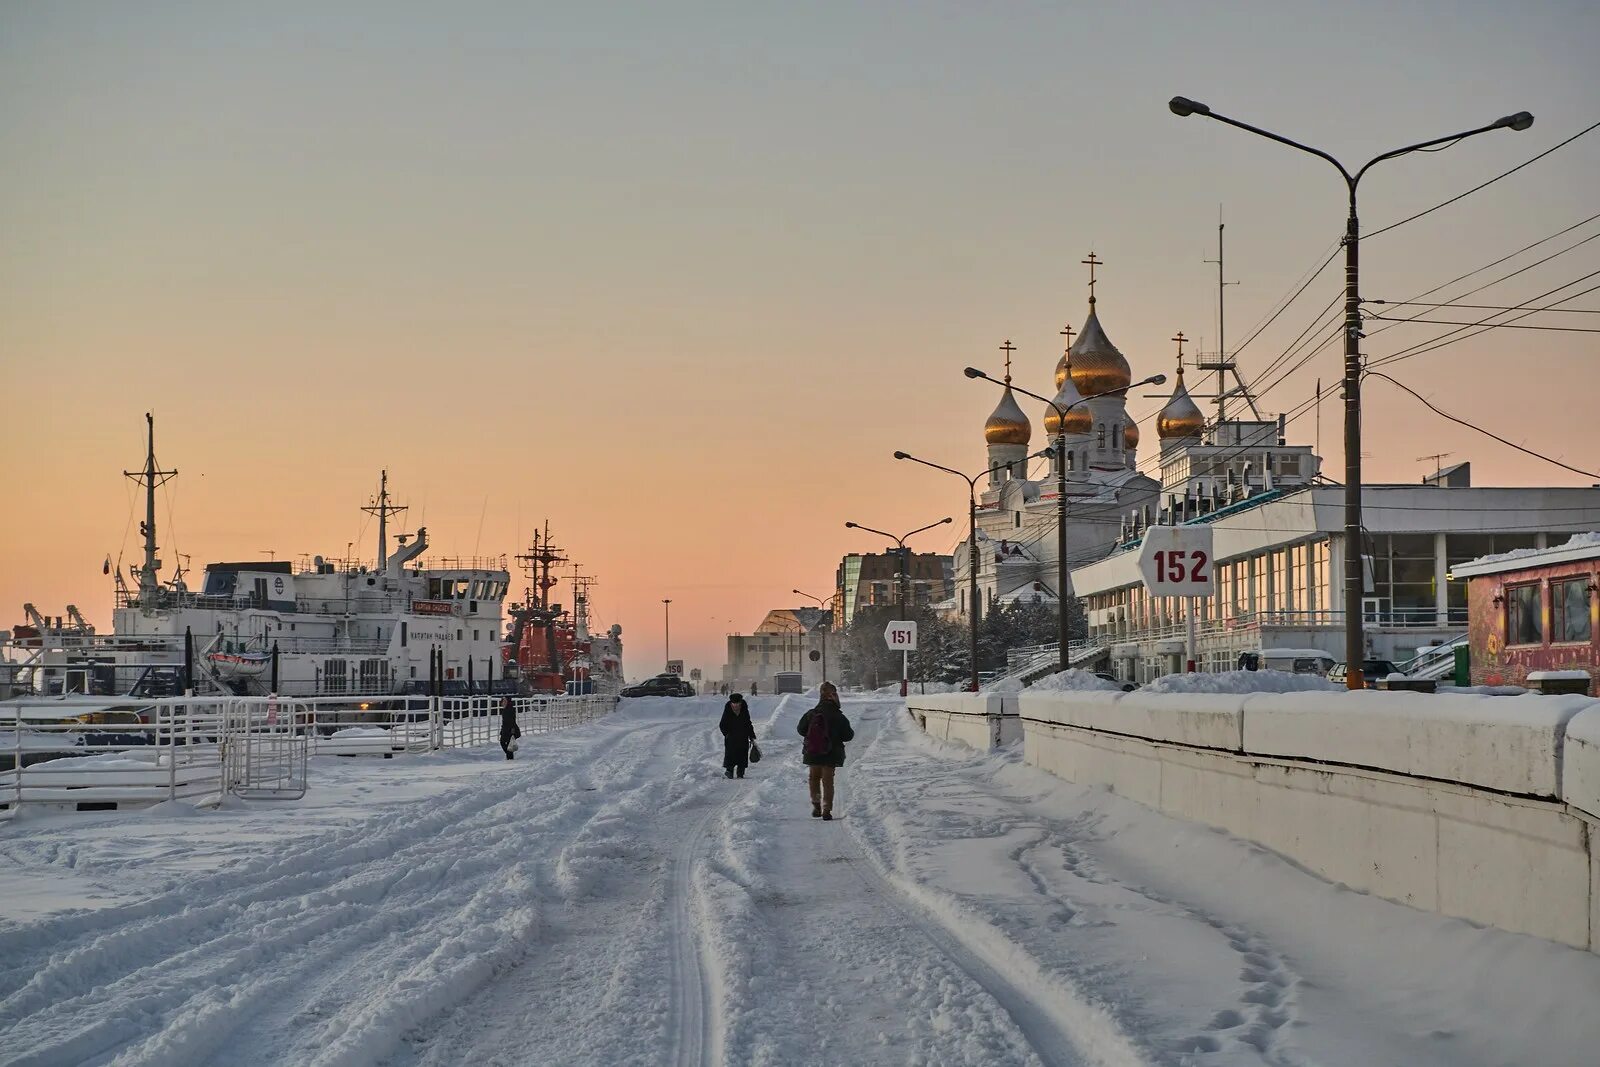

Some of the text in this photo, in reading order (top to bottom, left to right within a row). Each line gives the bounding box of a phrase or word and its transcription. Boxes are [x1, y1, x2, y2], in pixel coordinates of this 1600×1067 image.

[1154, 551, 1208, 582] 152
[892, 630, 911, 644] 151
[668, 665, 682, 673] 150
